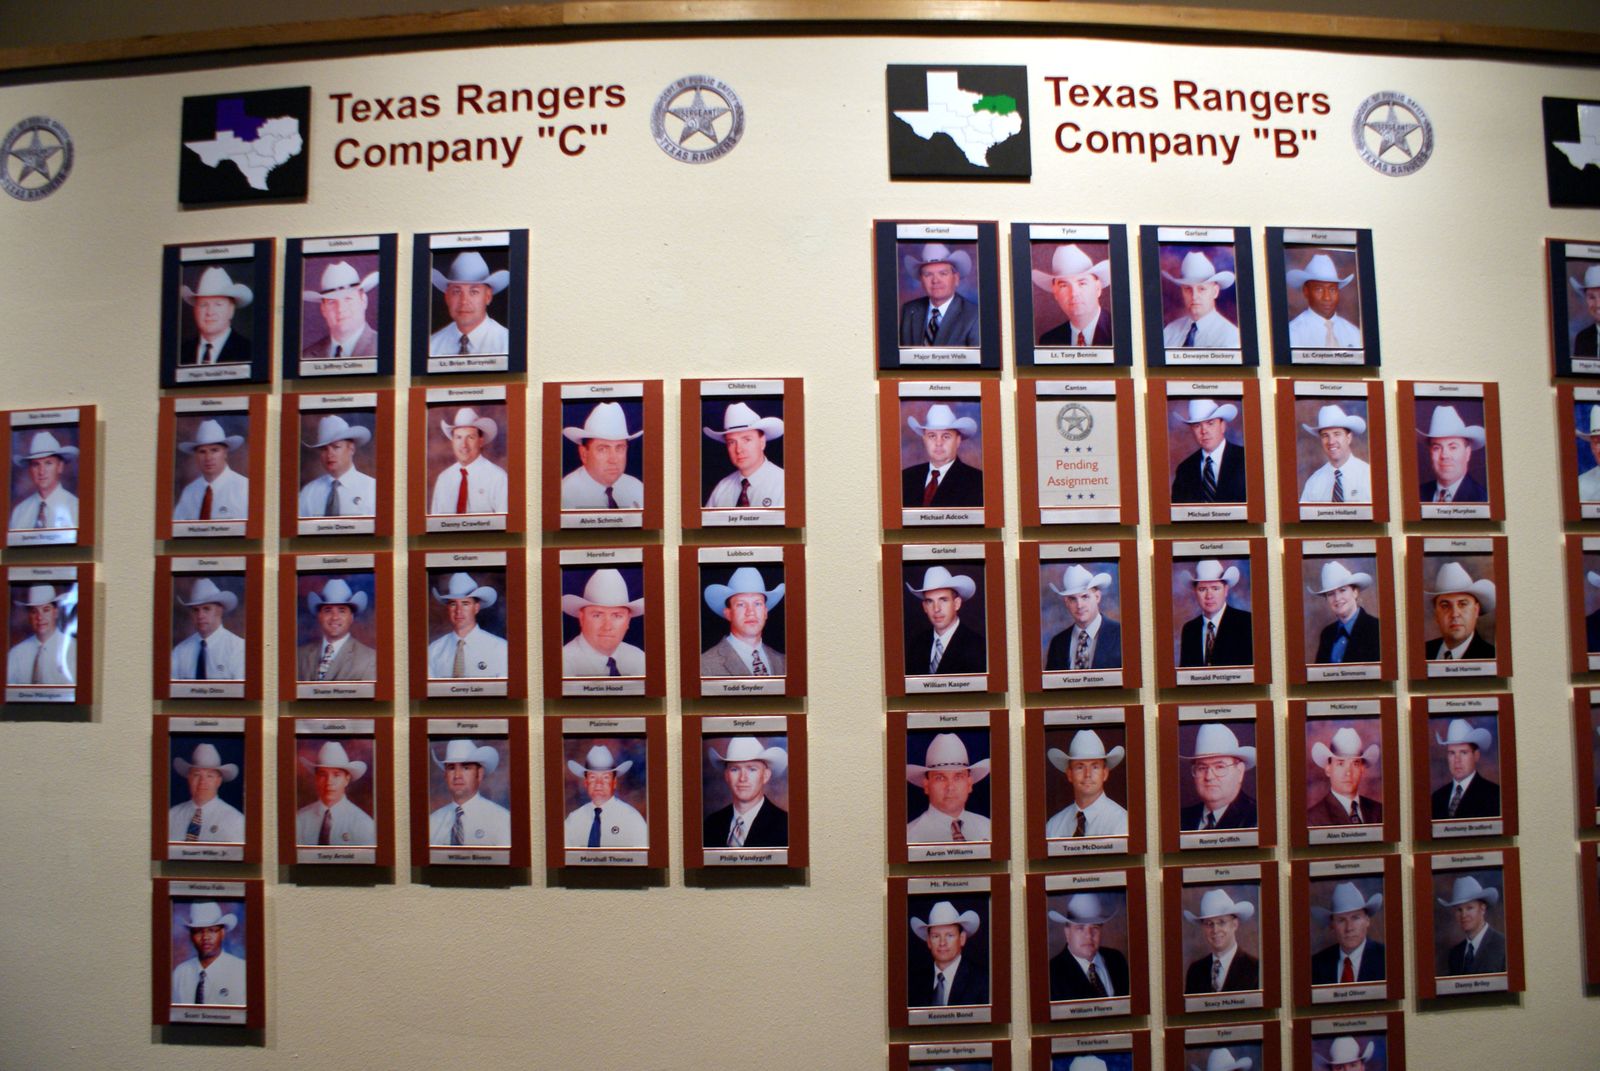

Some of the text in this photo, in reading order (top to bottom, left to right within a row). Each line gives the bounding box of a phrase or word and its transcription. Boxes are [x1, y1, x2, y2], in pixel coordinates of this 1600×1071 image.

[329, 92, 441, 124] Texas
[456, 83, 626, 119] Rangers
[1044, 76, 1159, 109] Texas
[1173, 79, 1331, 121] Rangers
[334, 123, 608, 172] Company "C"
[661, 136, 737, 161] TEXAS RANGERS
[1055, 122, 1317, 165] Company "B"
[1047, 476, 1109, 488] Assignment
[1056, 460, 1099, 471] Pending
